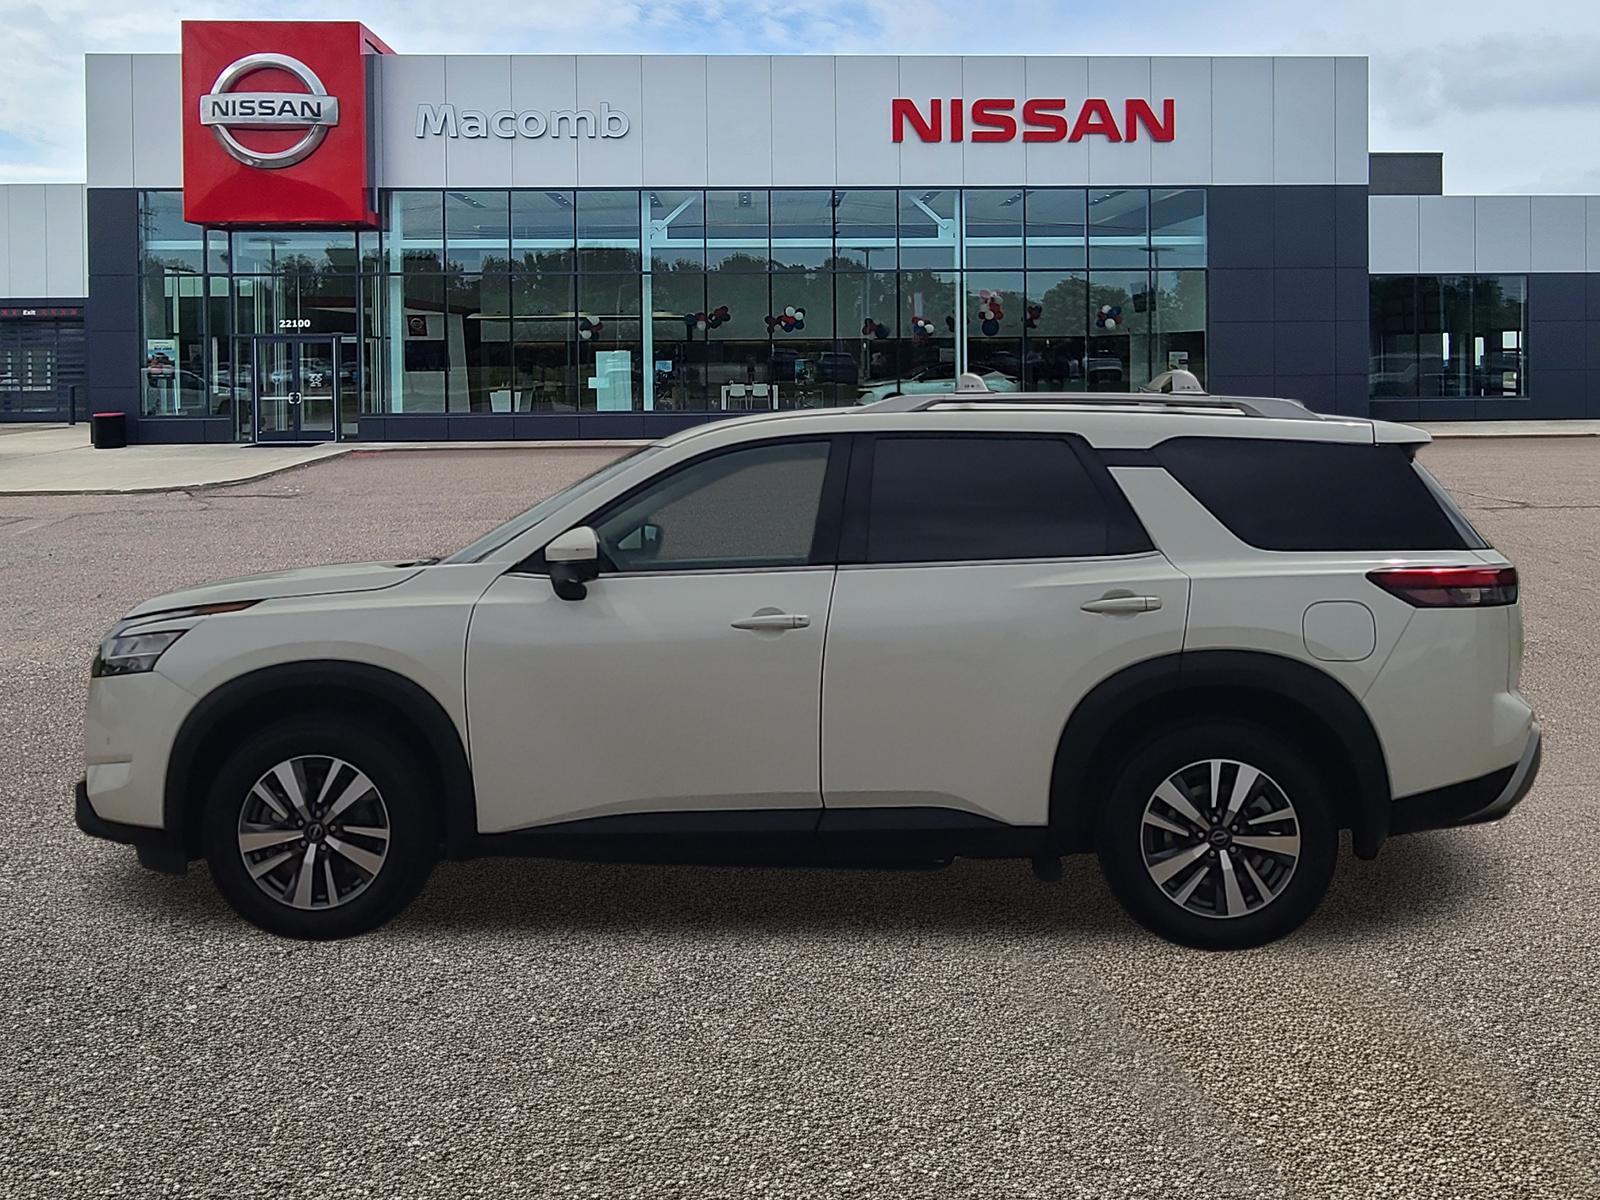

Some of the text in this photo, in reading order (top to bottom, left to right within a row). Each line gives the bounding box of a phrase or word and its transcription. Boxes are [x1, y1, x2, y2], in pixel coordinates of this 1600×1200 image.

[211, 99, 322, 118] NISSAN
[415, 103, 630, 138] Macomb
[892, 98, 1175, 142] NISSAN
[279, 319, 311, 328] 22100
